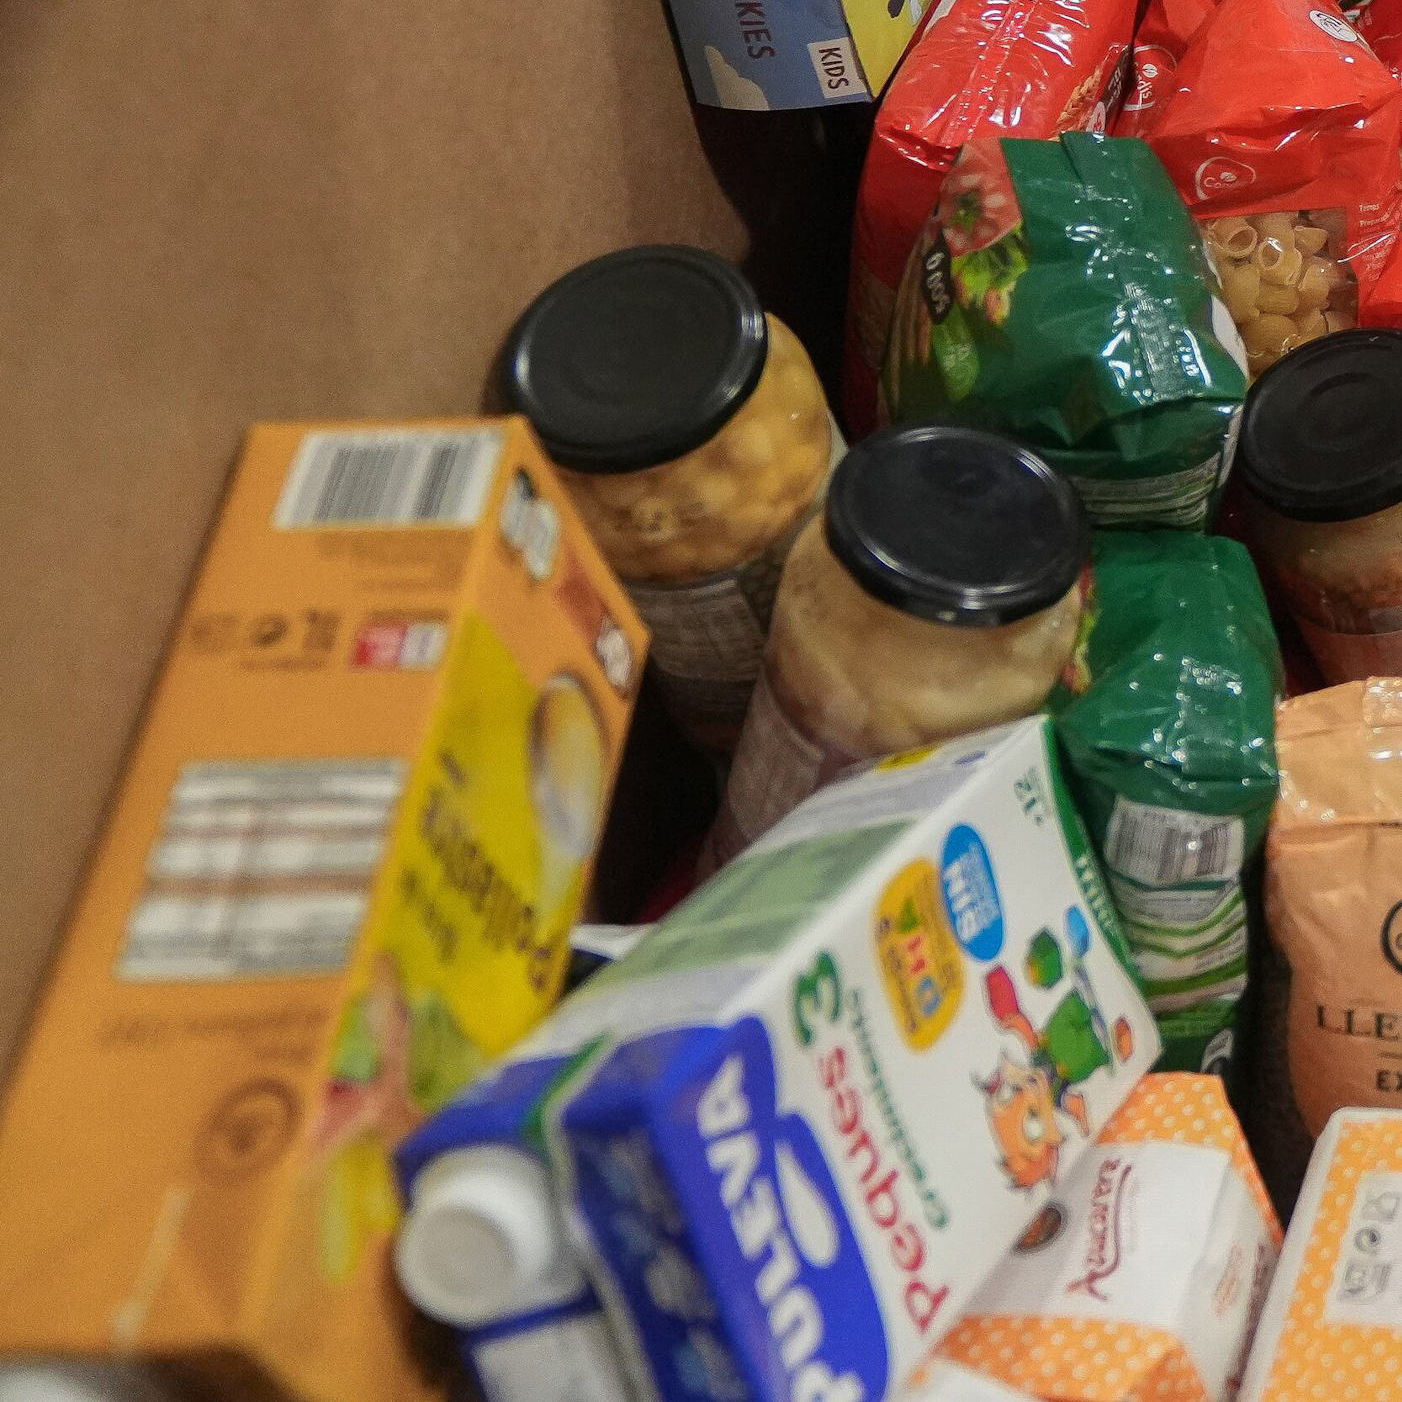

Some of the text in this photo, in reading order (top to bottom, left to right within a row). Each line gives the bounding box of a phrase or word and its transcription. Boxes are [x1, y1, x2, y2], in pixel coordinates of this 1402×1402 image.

[820, 46, 851, 90] KIDS
[790, 949, 846, 1048] 3
[696, 1054, 866, 1402] PULEVA
[817, 1045, 951, 1335] Peques
